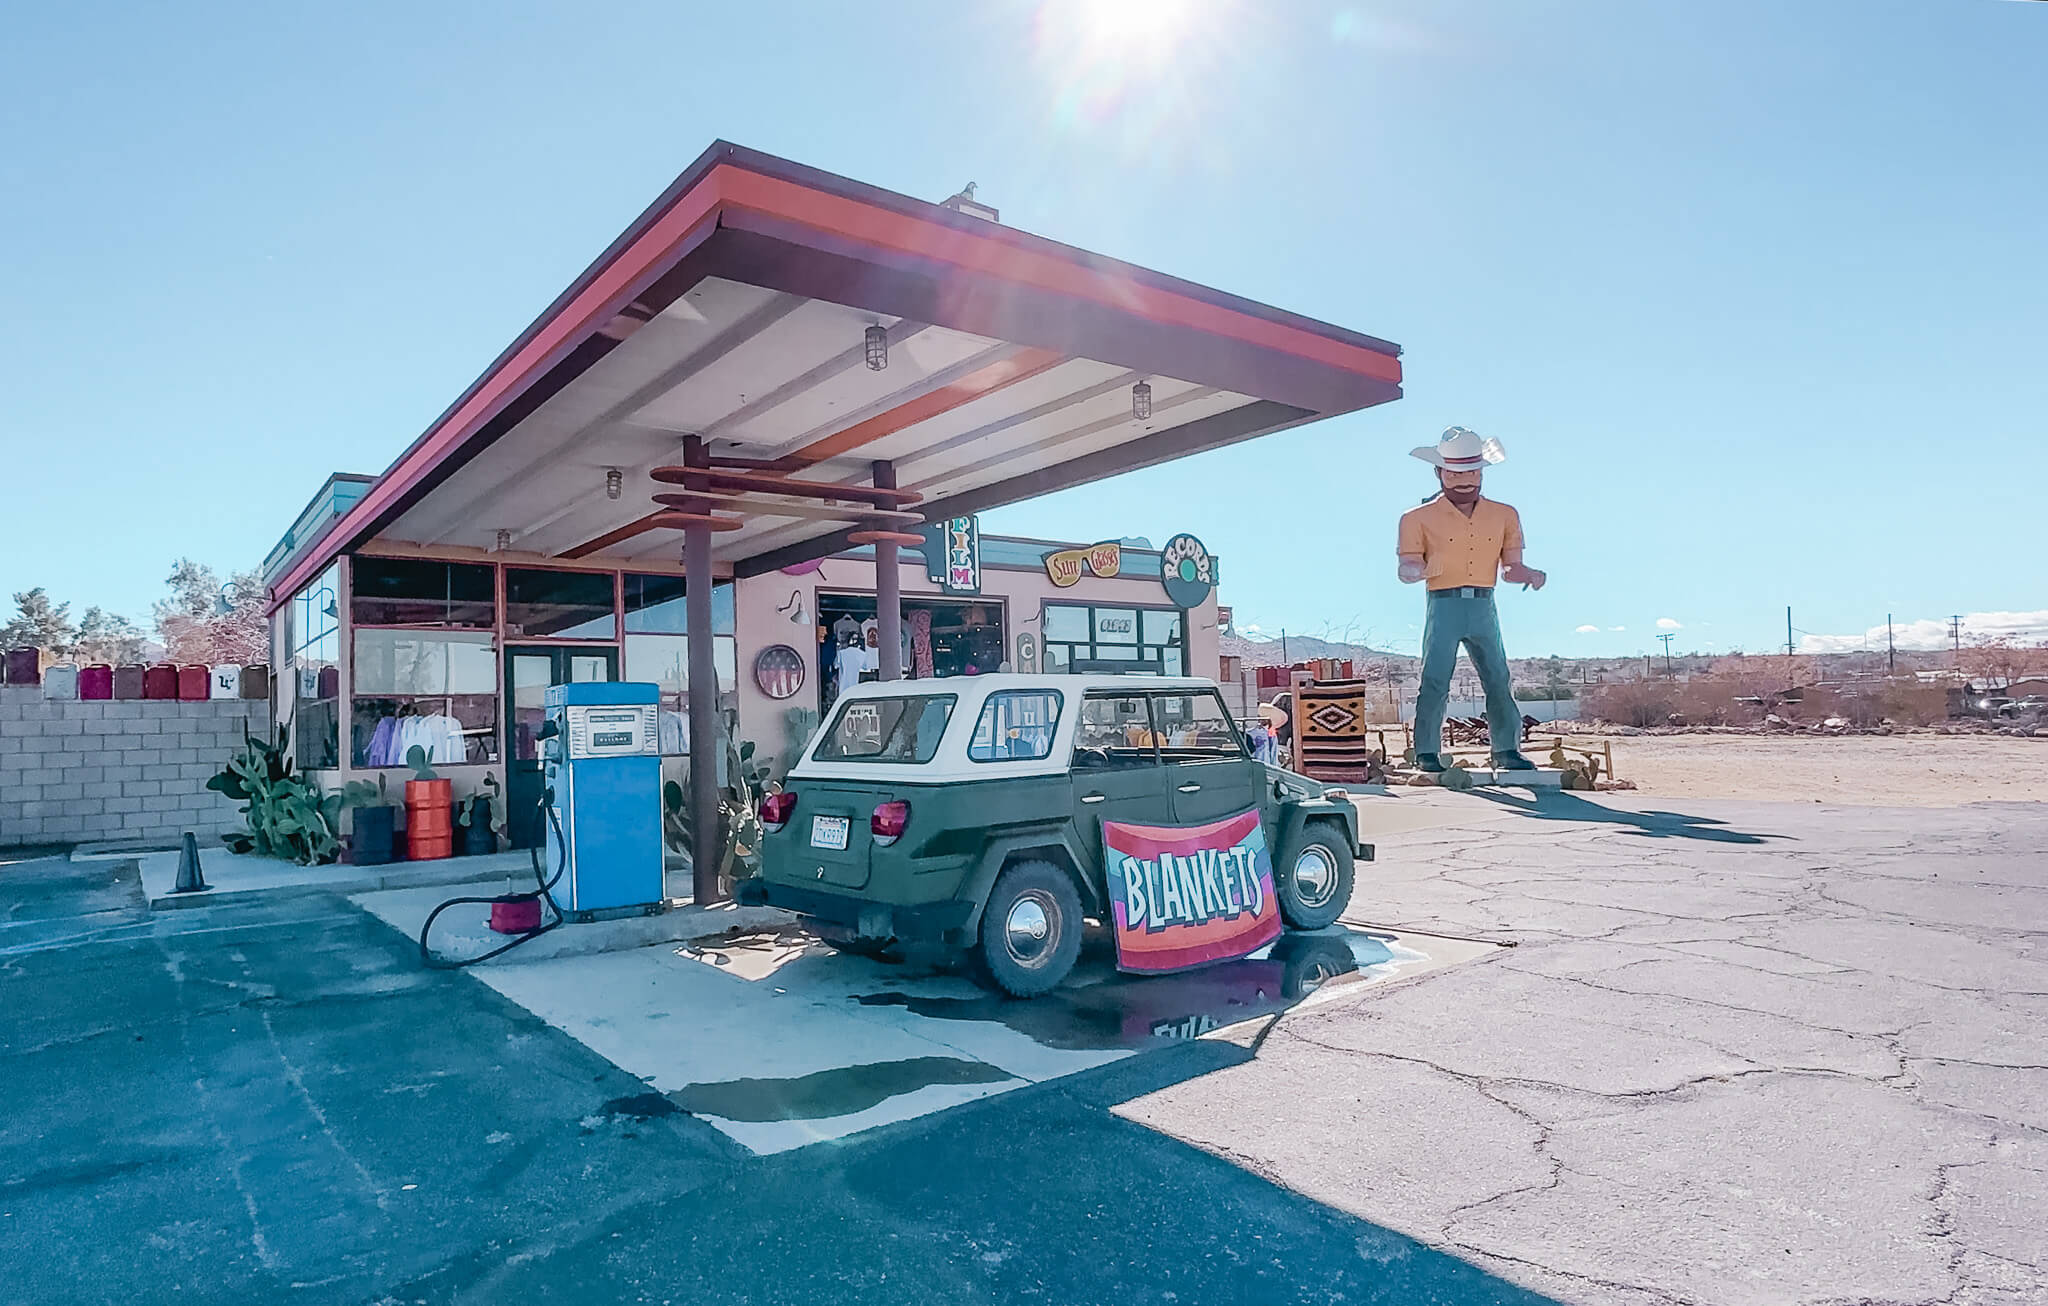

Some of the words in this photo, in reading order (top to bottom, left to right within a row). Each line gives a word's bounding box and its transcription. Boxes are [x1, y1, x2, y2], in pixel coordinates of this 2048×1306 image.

[951, 517, 974, 589] FILM
[1053, 557, 1080, 580] Sun
[1163, 537, 1210, 584] RECORDS
[1121, 845, 1264, 931] BLANKETS
